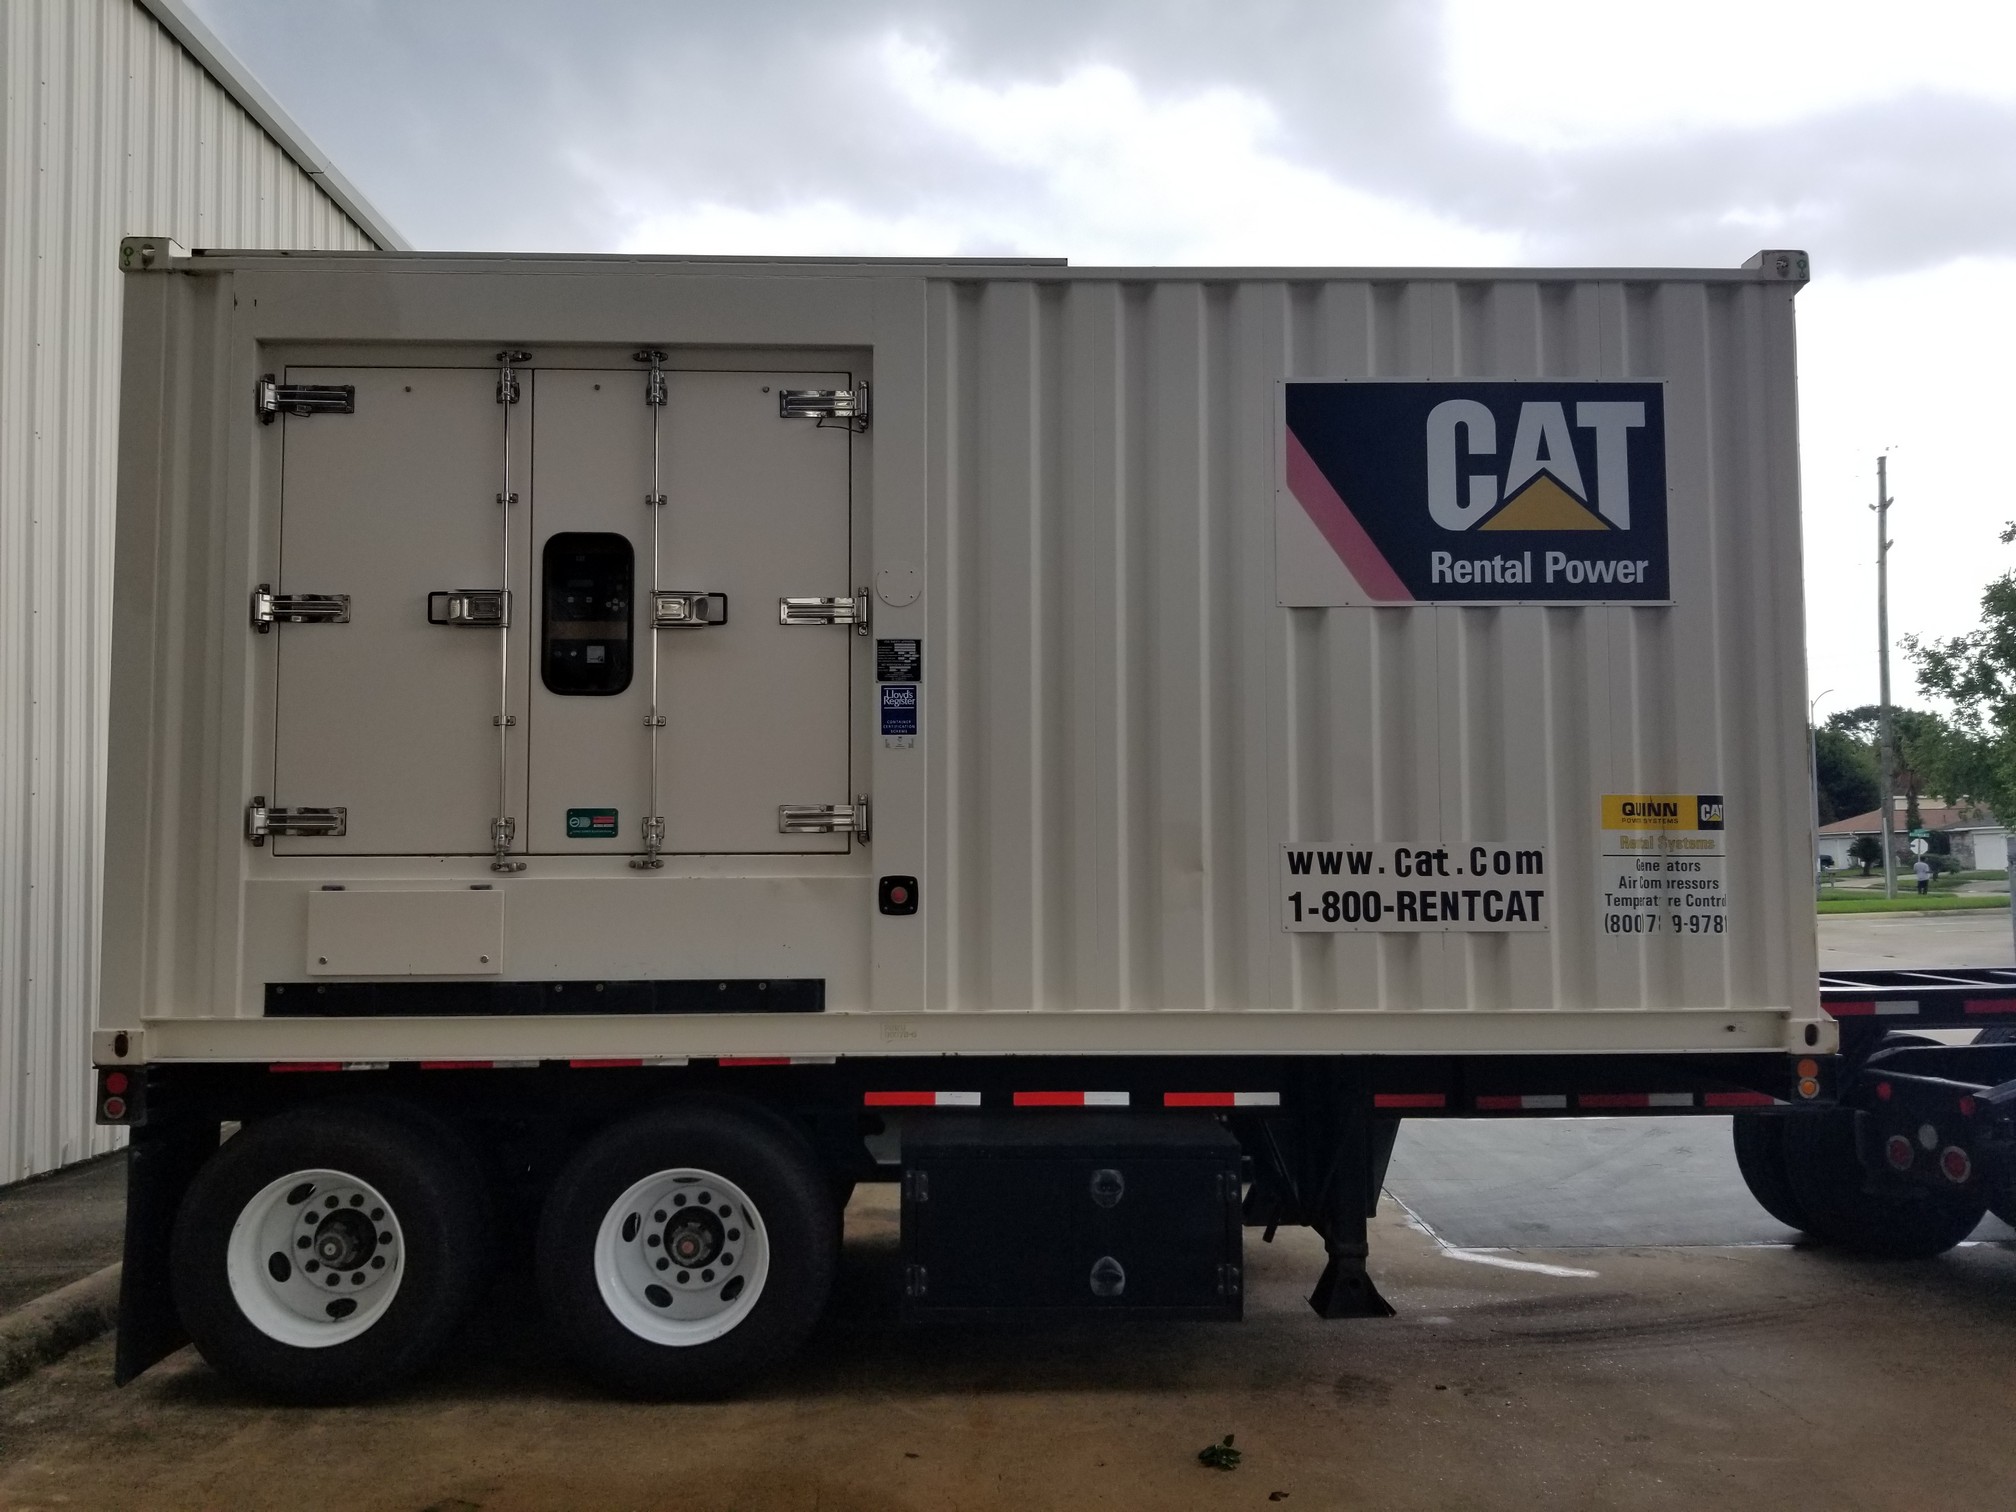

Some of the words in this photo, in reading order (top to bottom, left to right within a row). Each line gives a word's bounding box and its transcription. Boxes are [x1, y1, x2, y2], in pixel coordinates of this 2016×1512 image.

[1426, 399, 1646, 531] CAT
[1431, 551, 1532, 584] Rental
[1545, 551, 1649, 584] Power
[883, 695, 916, 707] Register
[886, 689, 914, 699] Lloyd's
[1621, 801, 1678, 817] QUINN
[1700, 803, 1724, 822] CAT
[1657, 834, 1716, 852] Systems
[1635, 857, 1702, 872] Geneators
[1618, 875, 1638, 889] Air
[1288, 889, 1545, 923] 1-800-RENTCAT
